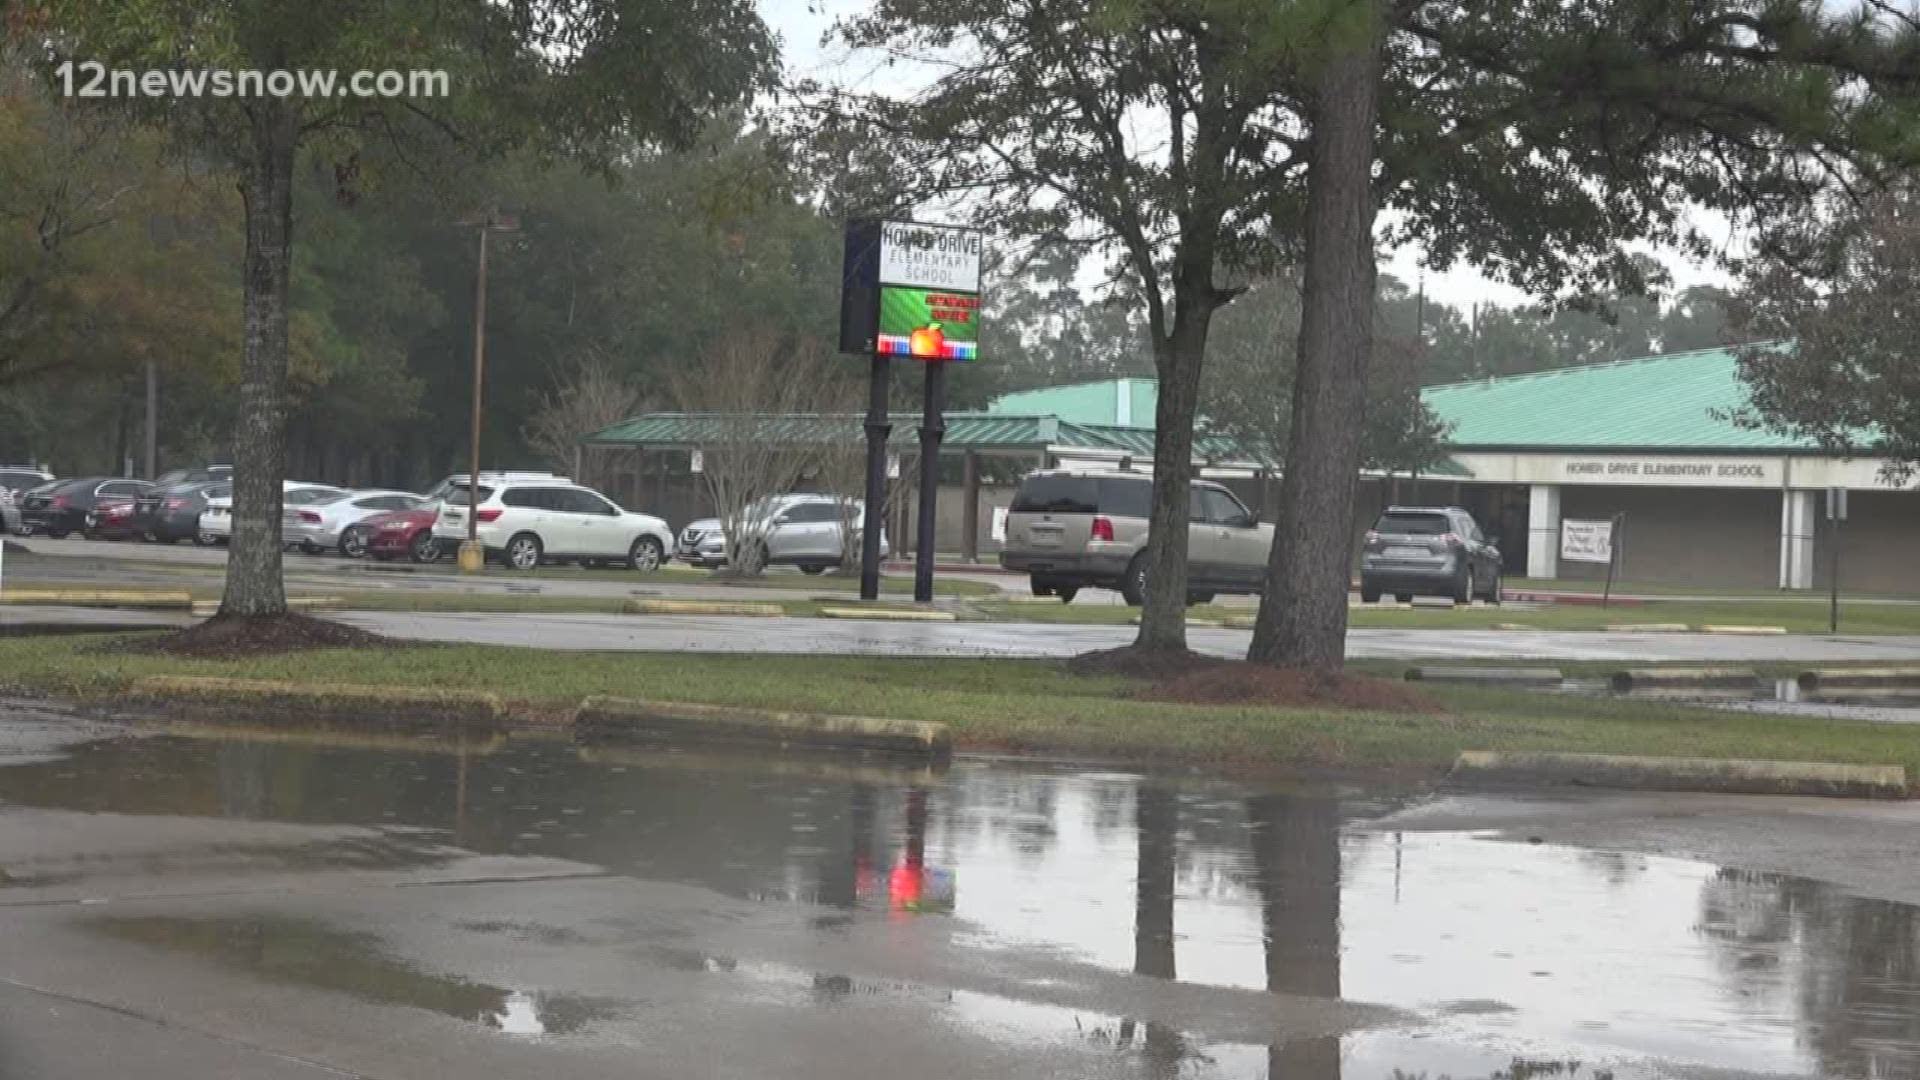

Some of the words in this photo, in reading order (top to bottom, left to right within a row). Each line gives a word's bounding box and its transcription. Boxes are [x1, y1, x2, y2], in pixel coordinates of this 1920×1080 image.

[939, 233, 979, 255] DRIVE
[890, 248, 969, 267] ELEMENTARY
[906, 264, 953, 283] SCHOOL
[1566, 462, 1604, 475] HOMER
[1607, 462, 1639, 475] DRIVE
[1643, 462, 1713, 476] ELEMENTARY
[1717, 464, 1764, 478] SCHOOL
